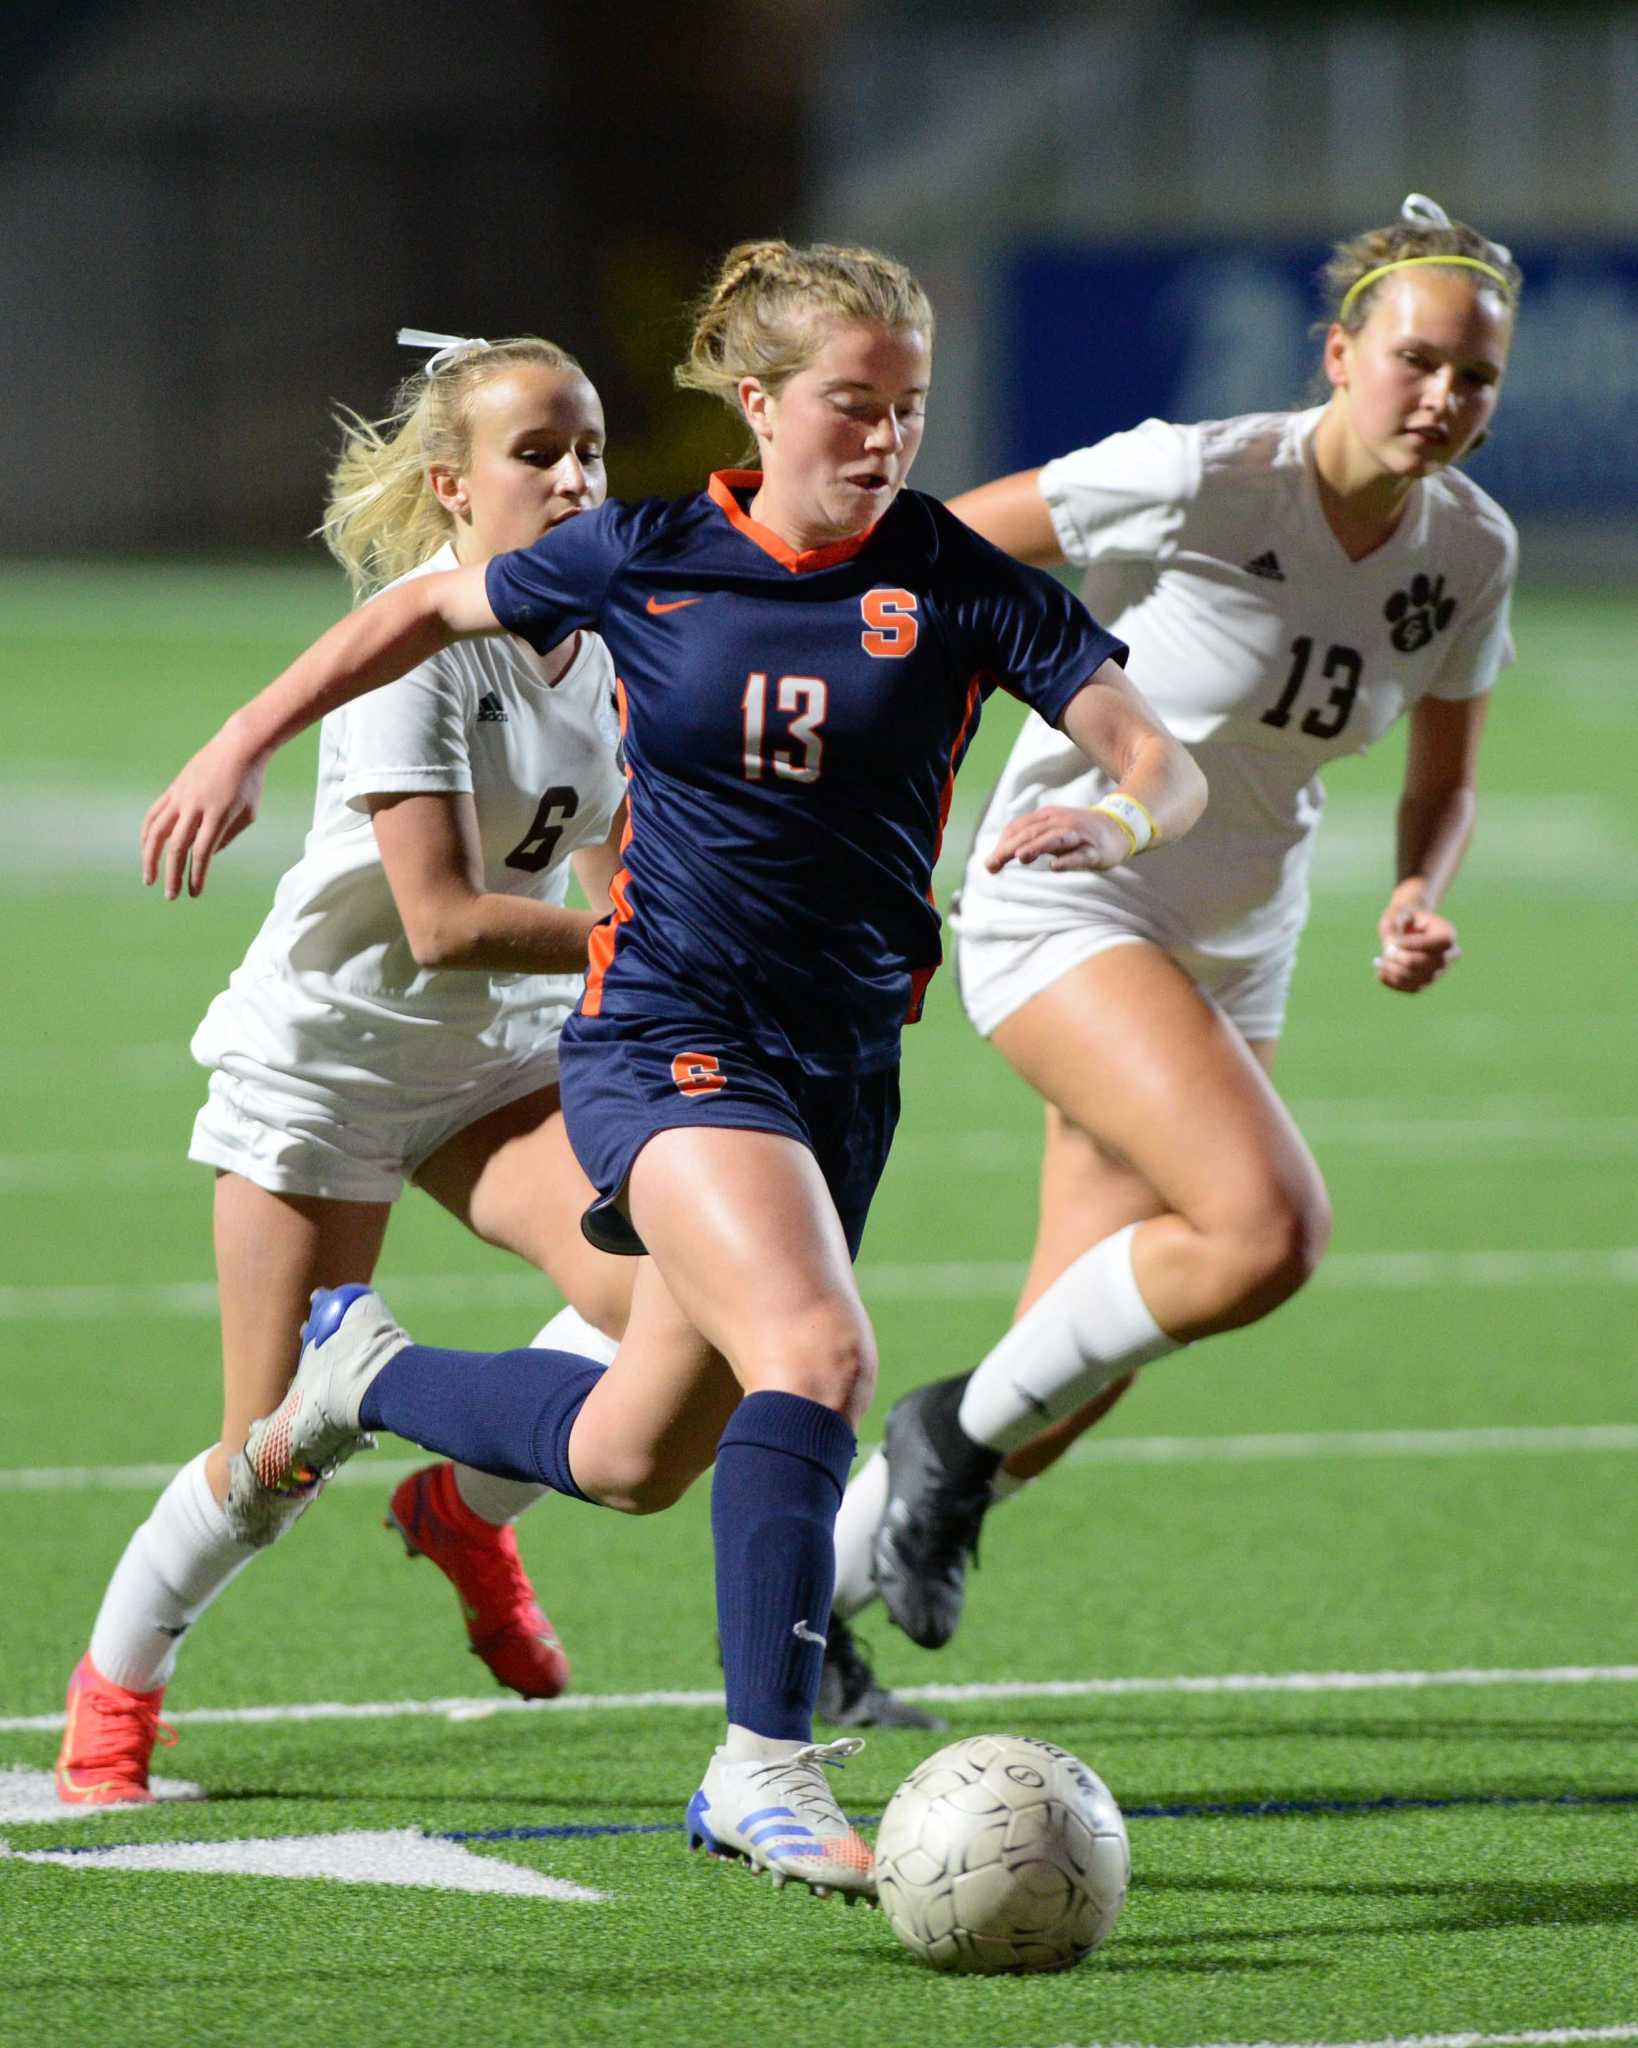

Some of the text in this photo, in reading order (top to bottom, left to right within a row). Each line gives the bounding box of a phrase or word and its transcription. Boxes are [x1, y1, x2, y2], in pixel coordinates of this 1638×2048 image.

[860, 587, 918, 658] S
[741, 672, 828, 784] 13
[1260, 635, 1363, 740] 13
[505, 785, 580, 873] 6
